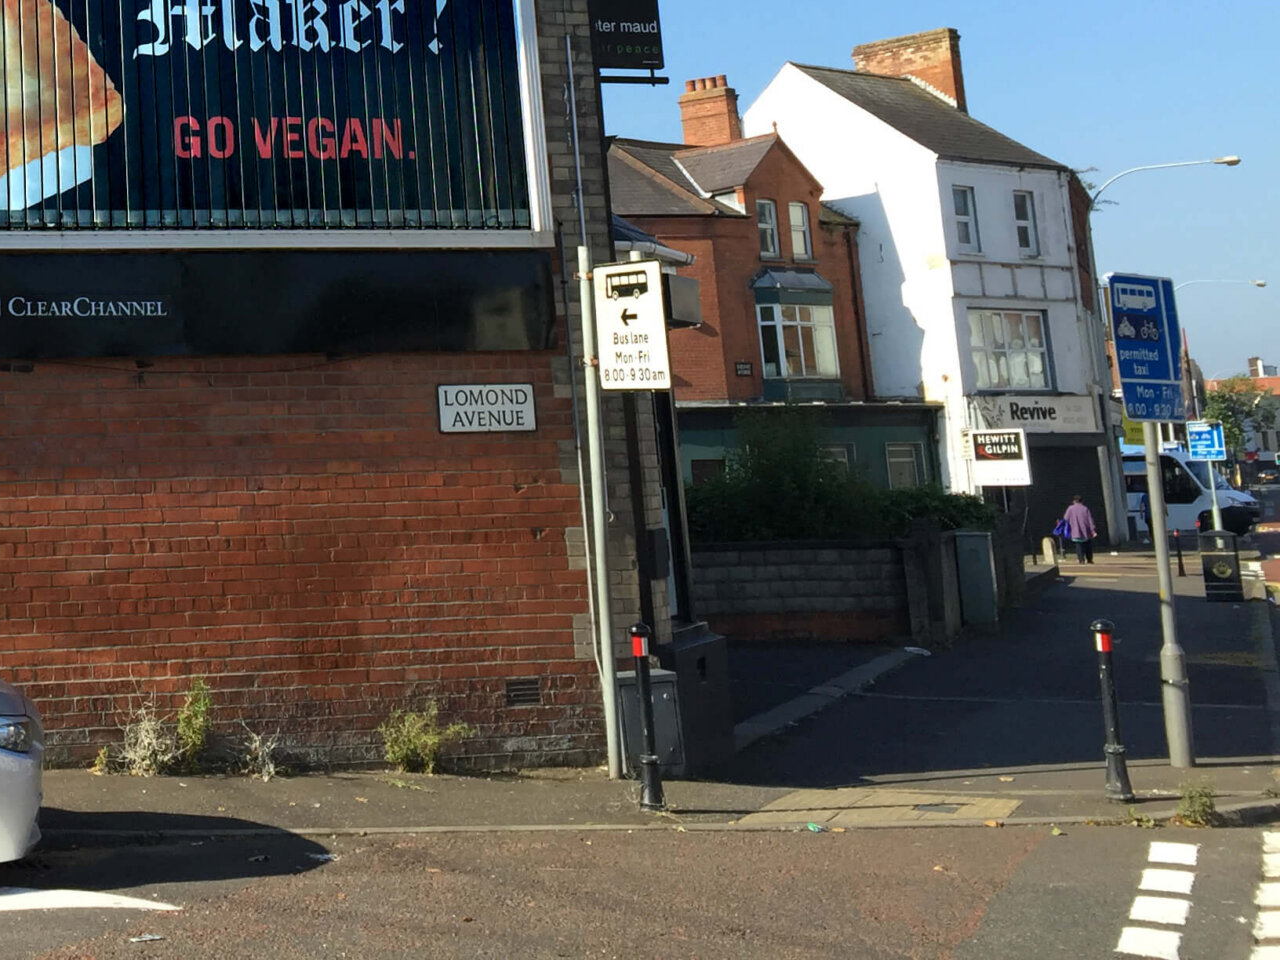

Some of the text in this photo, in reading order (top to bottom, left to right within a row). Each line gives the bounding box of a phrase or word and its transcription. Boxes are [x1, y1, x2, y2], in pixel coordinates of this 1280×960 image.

[595, 18, 658, 34] ter maud
[616, 44, 659, 55] peace
[173, 116, 416, 160] GO VEGAN.
[613, 331, 648, 345] Bus lane
[615, 351, 633, 364] Mon
[638, 350, 650, 363] Fri
[1120, 349, 1159, 361] permitted
[1133, 362, 1150, 375] taxi
[444, 389, 528, 407] LOMOND
[1136, 385, 1155, 398] Mon
[1009, 400, 1057, 421] Revive
[452, 410, 525, 428] AVENUE
[977, 434, 1016, 444] HEWITT
